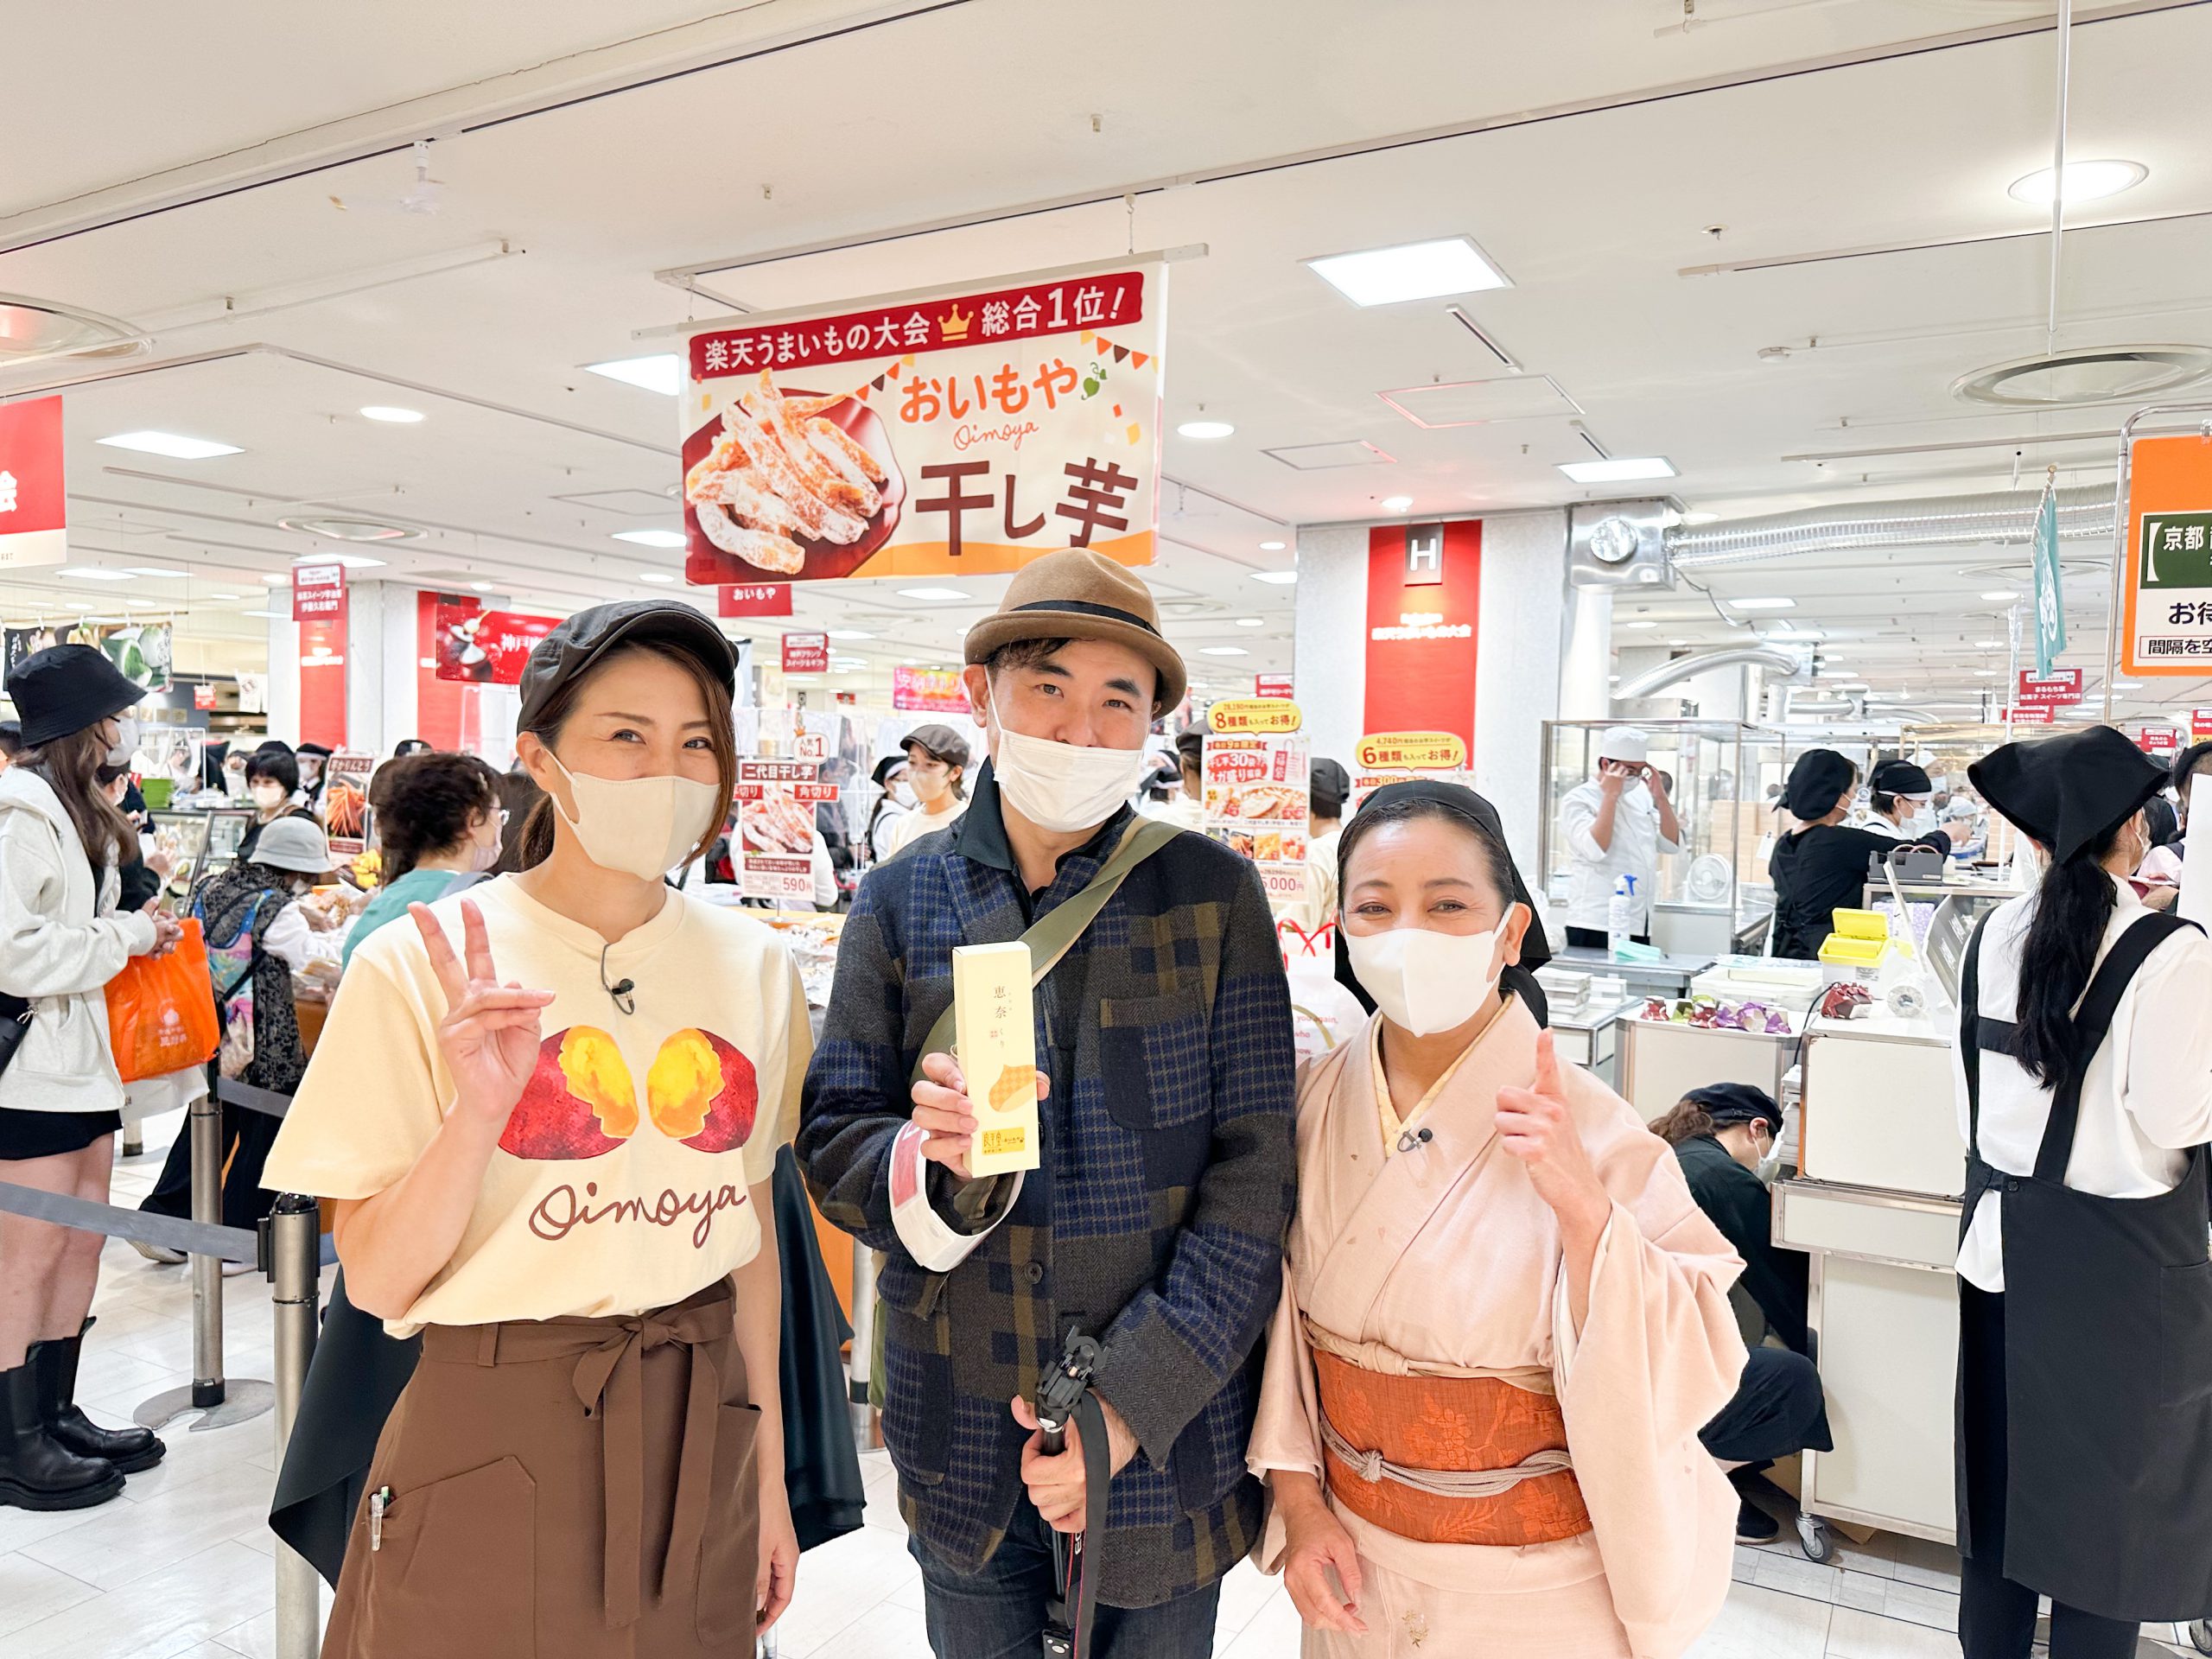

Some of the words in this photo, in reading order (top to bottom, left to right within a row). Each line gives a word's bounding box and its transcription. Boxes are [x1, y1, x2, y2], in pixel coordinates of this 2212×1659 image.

[704, 312, 931, 372] 楽天うまいもの大会
[981, 286, 1127, 337] 総合1位!
[899, 358, 1078, 423] おいもや
[952, 421, 1039, 451] Oimoya
[915, 456, 1139, 556] 干し芋
[1409, 537, 1437, 571] H
[733, 587, 777, 601] おいもや
[745, 764, 813, 779] 二代目干し芋
[799, 786, 831, 798] 角切り
[528, 1181, 747, 1249] Oimoya
